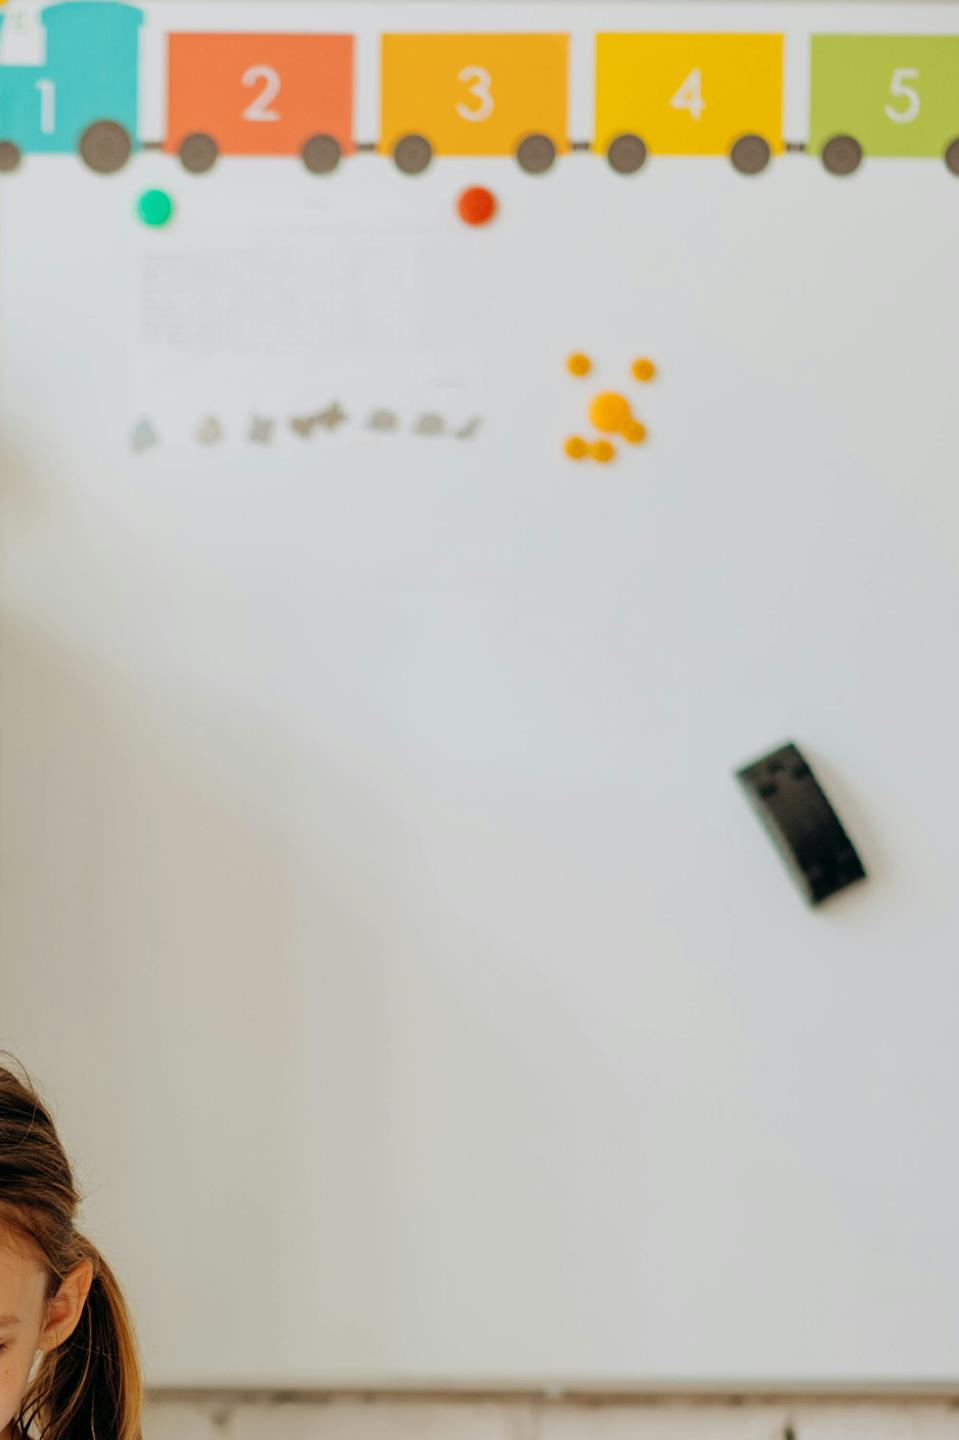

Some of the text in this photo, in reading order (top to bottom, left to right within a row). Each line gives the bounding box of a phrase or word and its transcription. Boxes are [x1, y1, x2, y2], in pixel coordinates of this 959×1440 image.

[34, 64, 922, 135] 1 2 3 4 5
